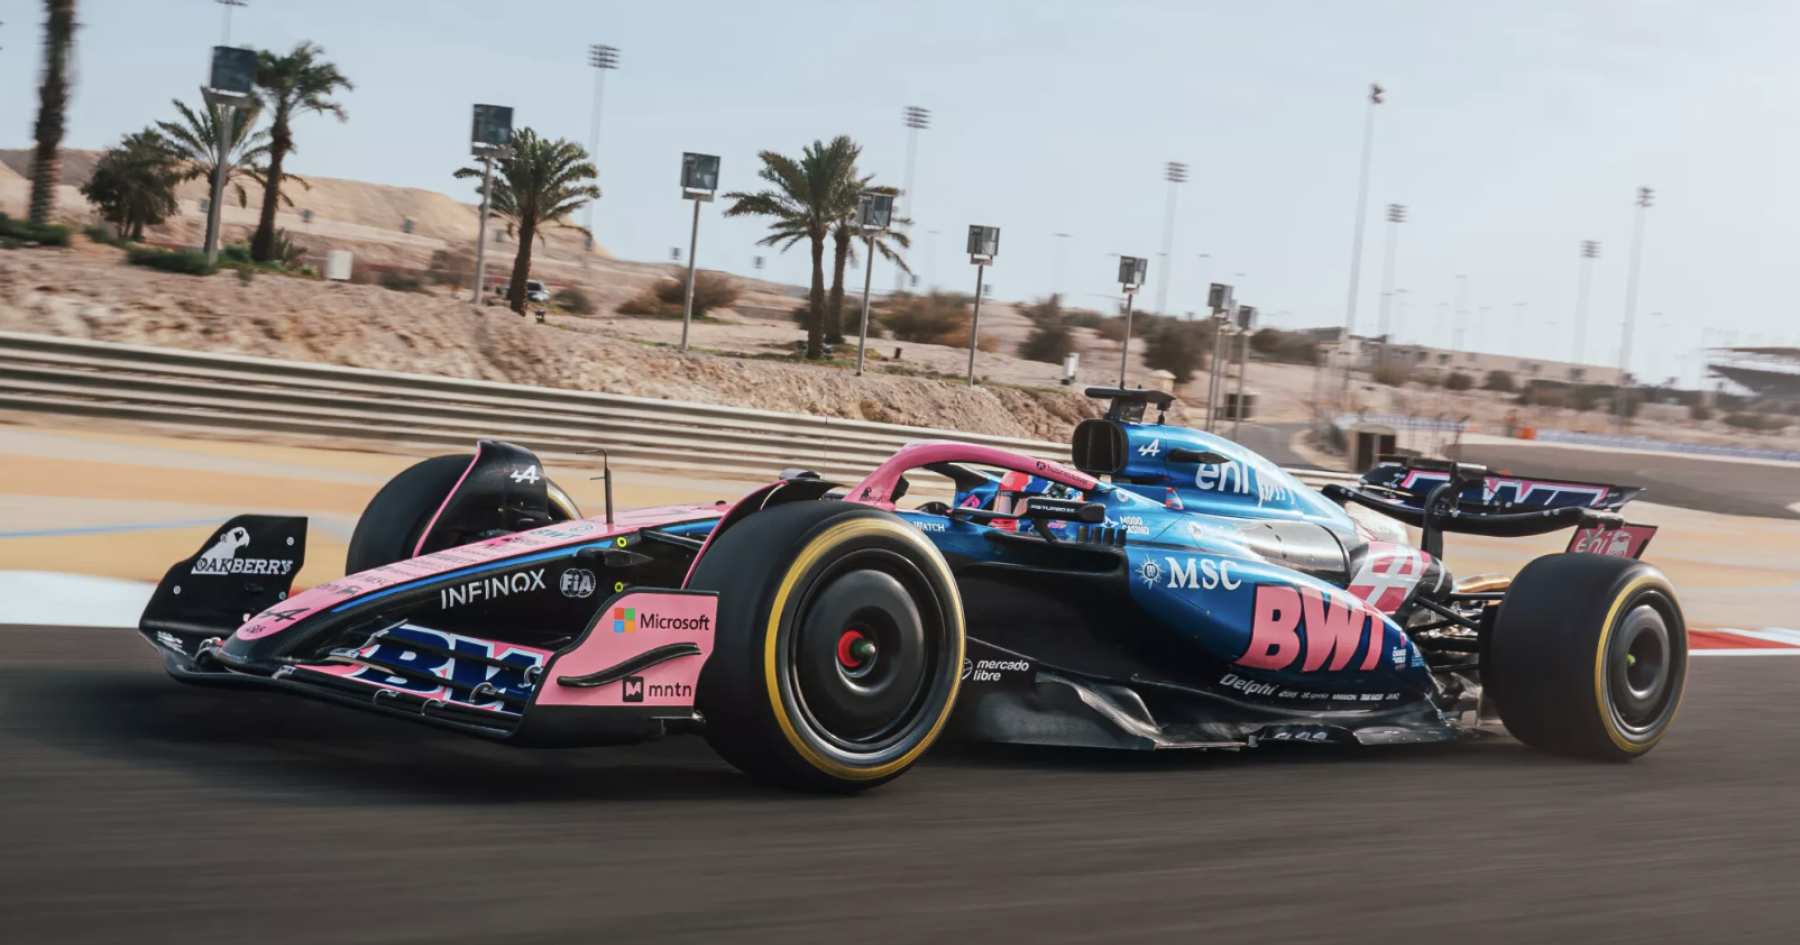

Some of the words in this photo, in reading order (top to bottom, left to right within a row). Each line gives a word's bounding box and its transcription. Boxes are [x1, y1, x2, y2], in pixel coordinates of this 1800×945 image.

[194, 558, 294, 575] OAKBERRY
[1165, 557, 1242, 590] MSC
[441, 568, 547, 609] INFINOX
[640, 613, 710, 631] Microsoft
[976, 659, 1030, 672] mercado
[972, 669, 1002, 682] libre
[648, 682, 693, 698] mntn
[1219, 673, 1280, 696] Delphi
